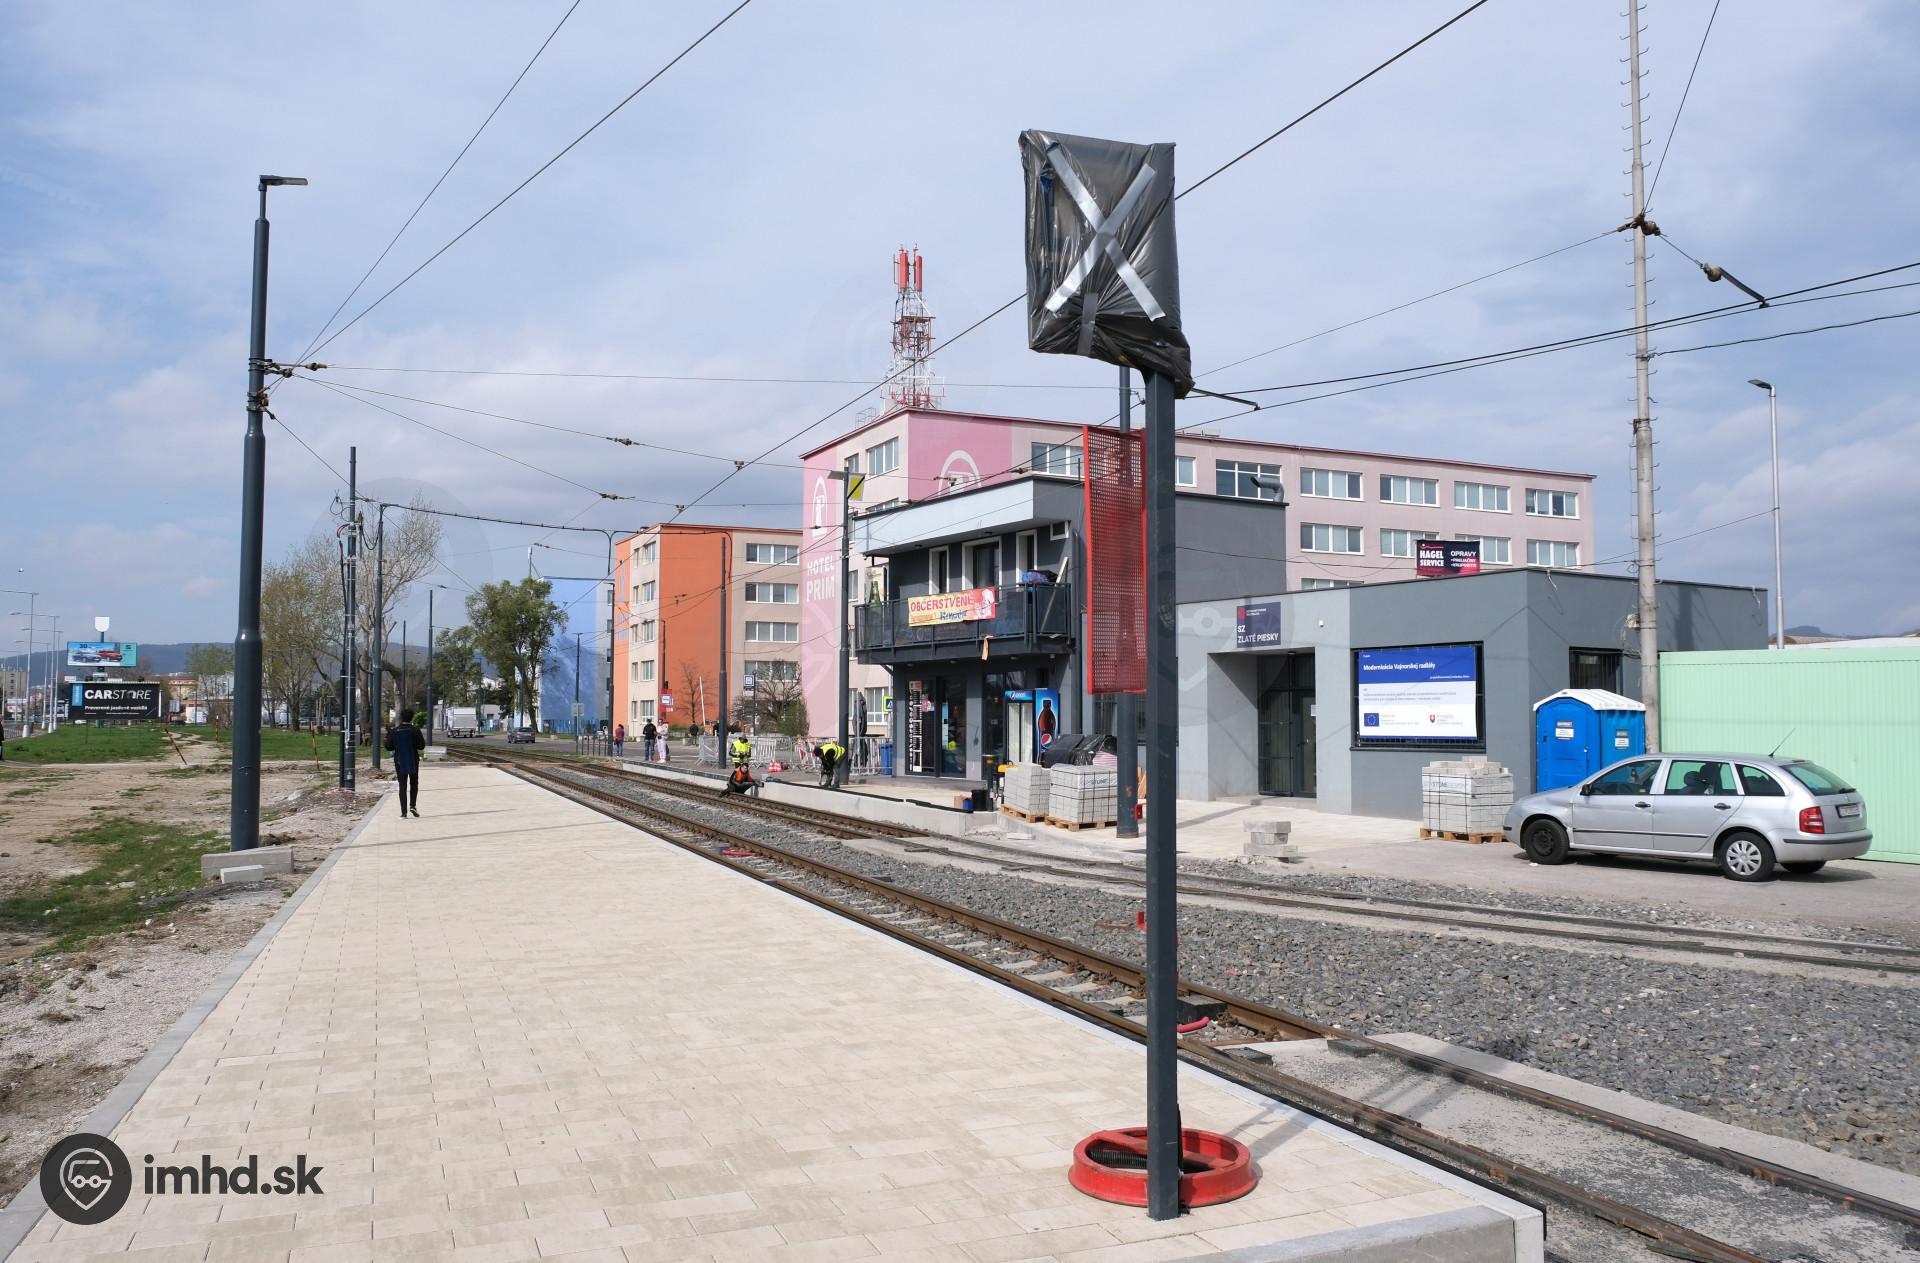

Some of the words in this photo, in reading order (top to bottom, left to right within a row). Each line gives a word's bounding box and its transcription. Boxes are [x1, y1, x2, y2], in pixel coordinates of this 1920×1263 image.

[1420, 550, 1444, 559] HAGEL
[808, 554, 835, 576] HOTEL
[806, 576, 835, 602] PRIM
[1238, 632, 1256, 643] ZLATÉ
[1257, 632, 1279, 642] PIESKY
[84, 689, 152, 700] CARSTORE
